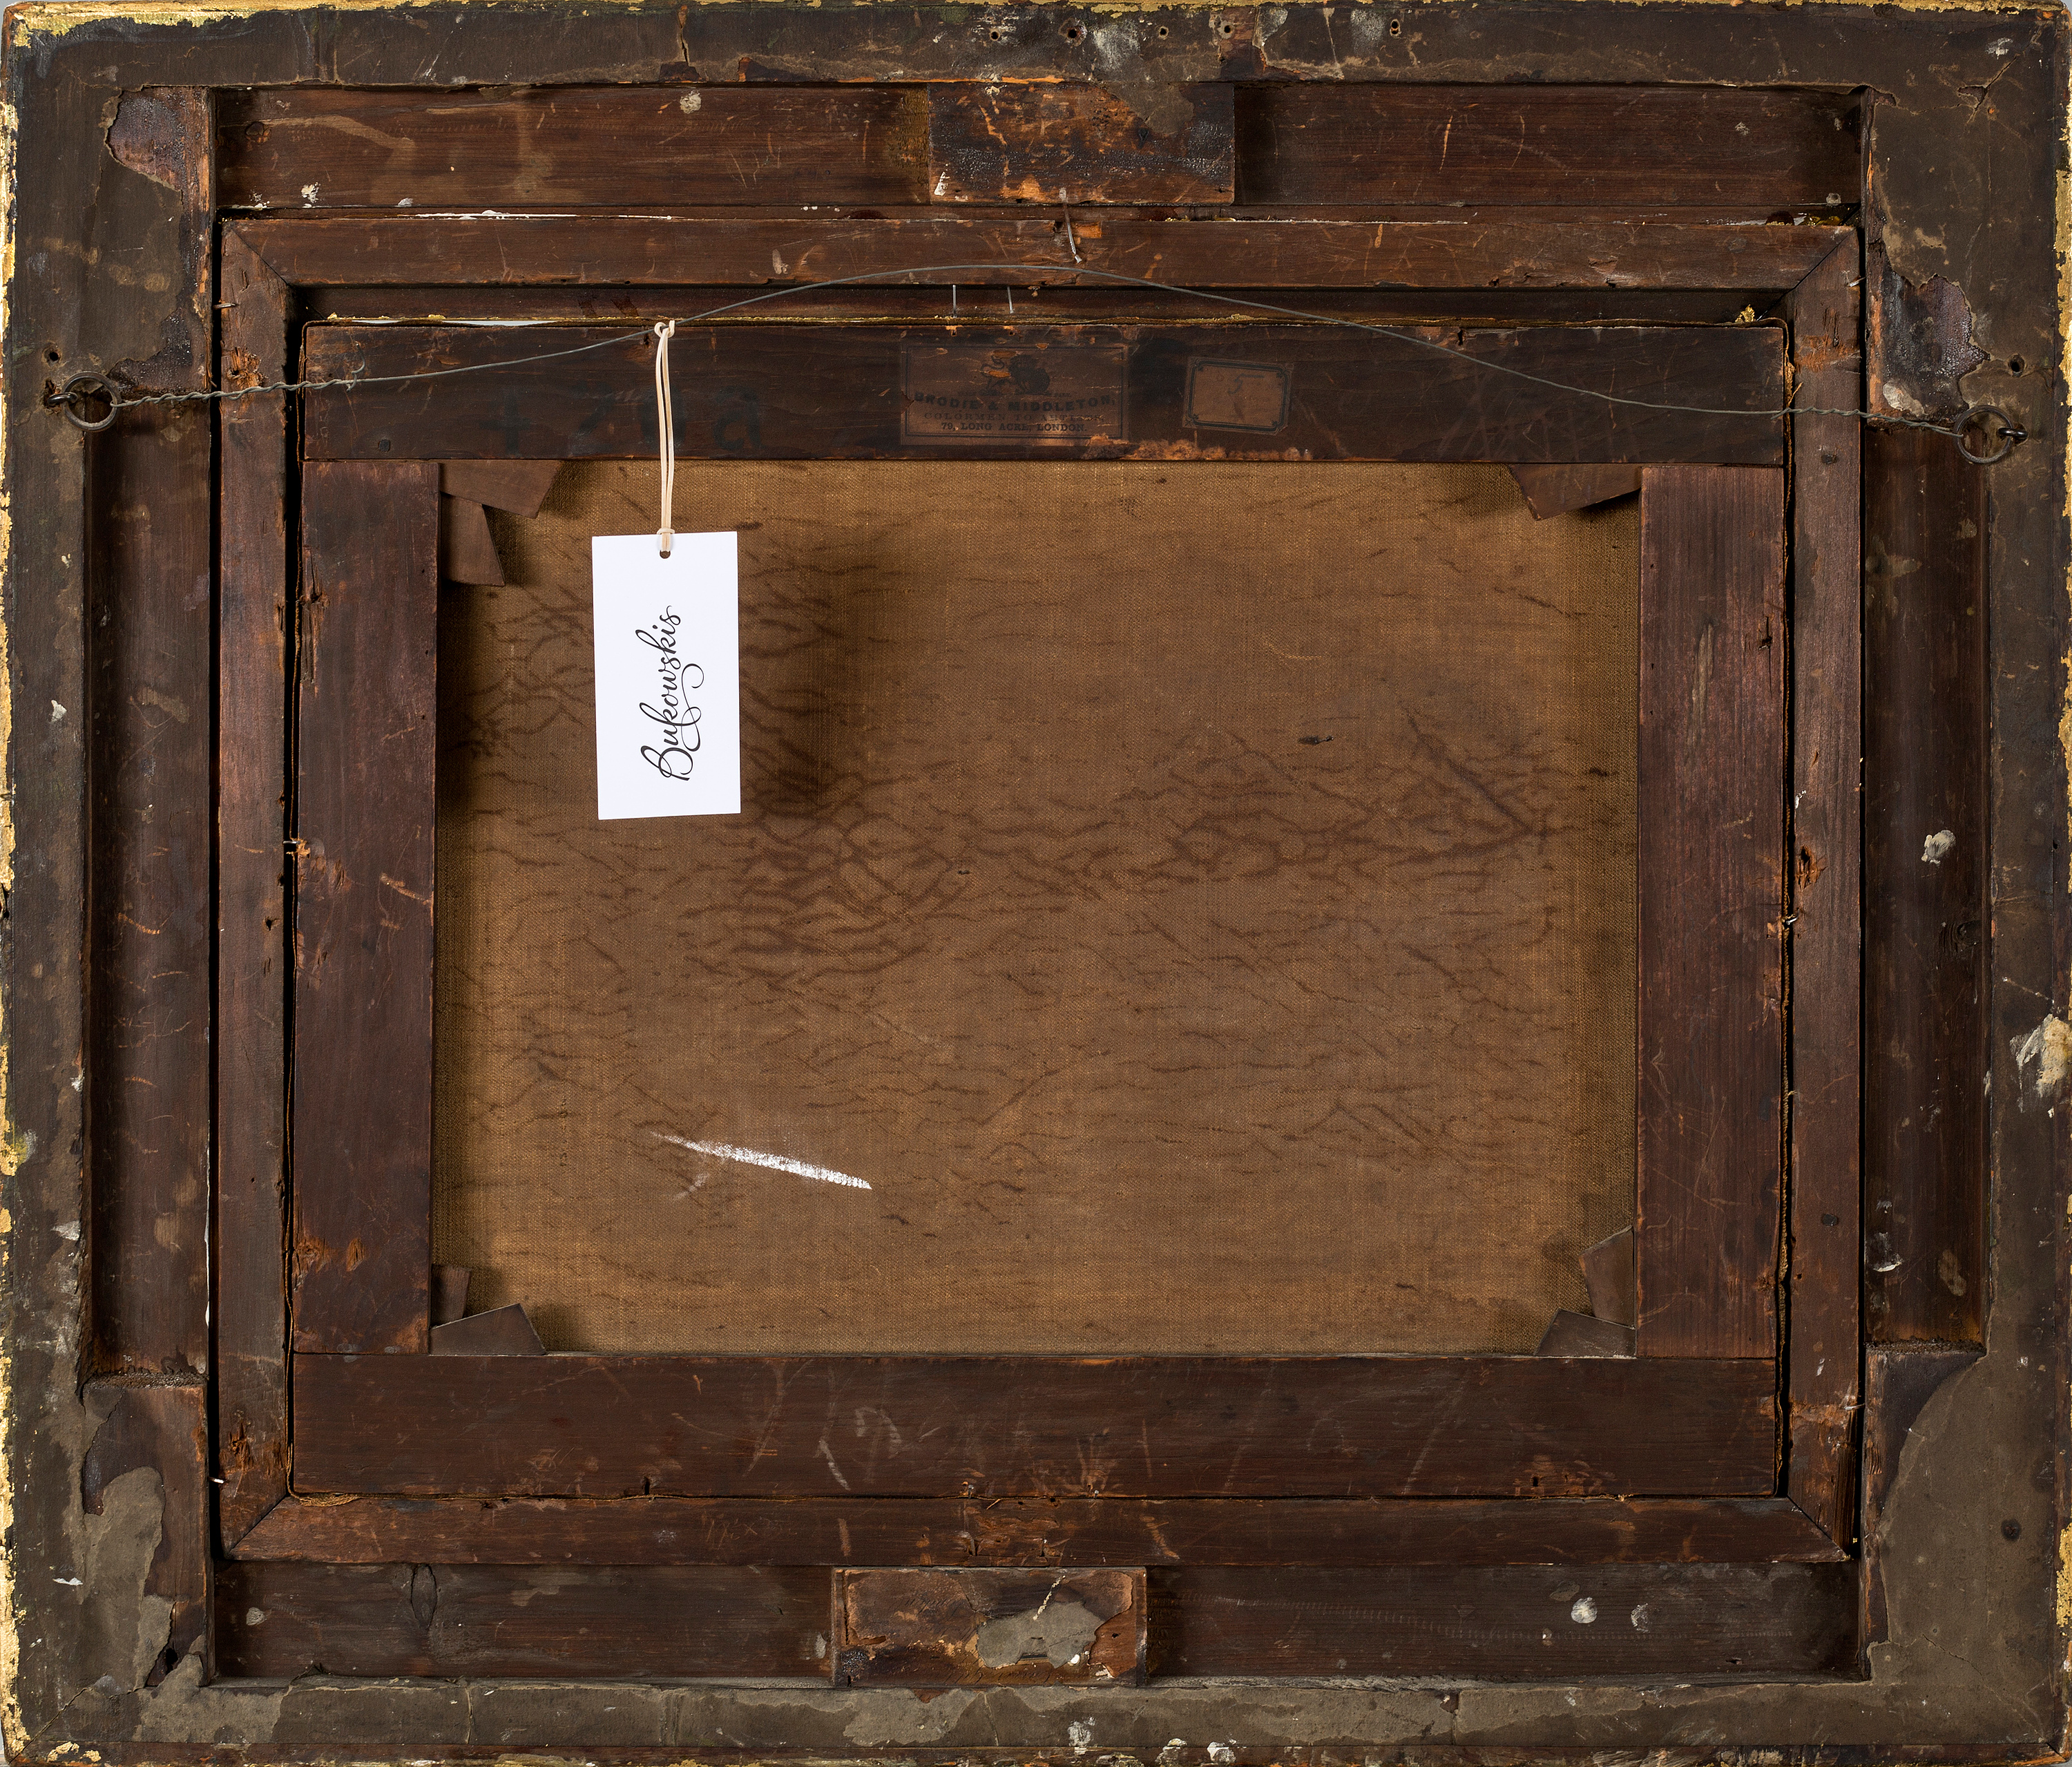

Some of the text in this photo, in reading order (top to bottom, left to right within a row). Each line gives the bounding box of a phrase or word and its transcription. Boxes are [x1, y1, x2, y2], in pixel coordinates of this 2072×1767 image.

[914, 392, 1116, 412] BRODIE & MIDDLETON,
[941, 422, 1088, 433] 79, LONG ACRE, LONDON.
[635, 604, 704, 782] Bukowskis
